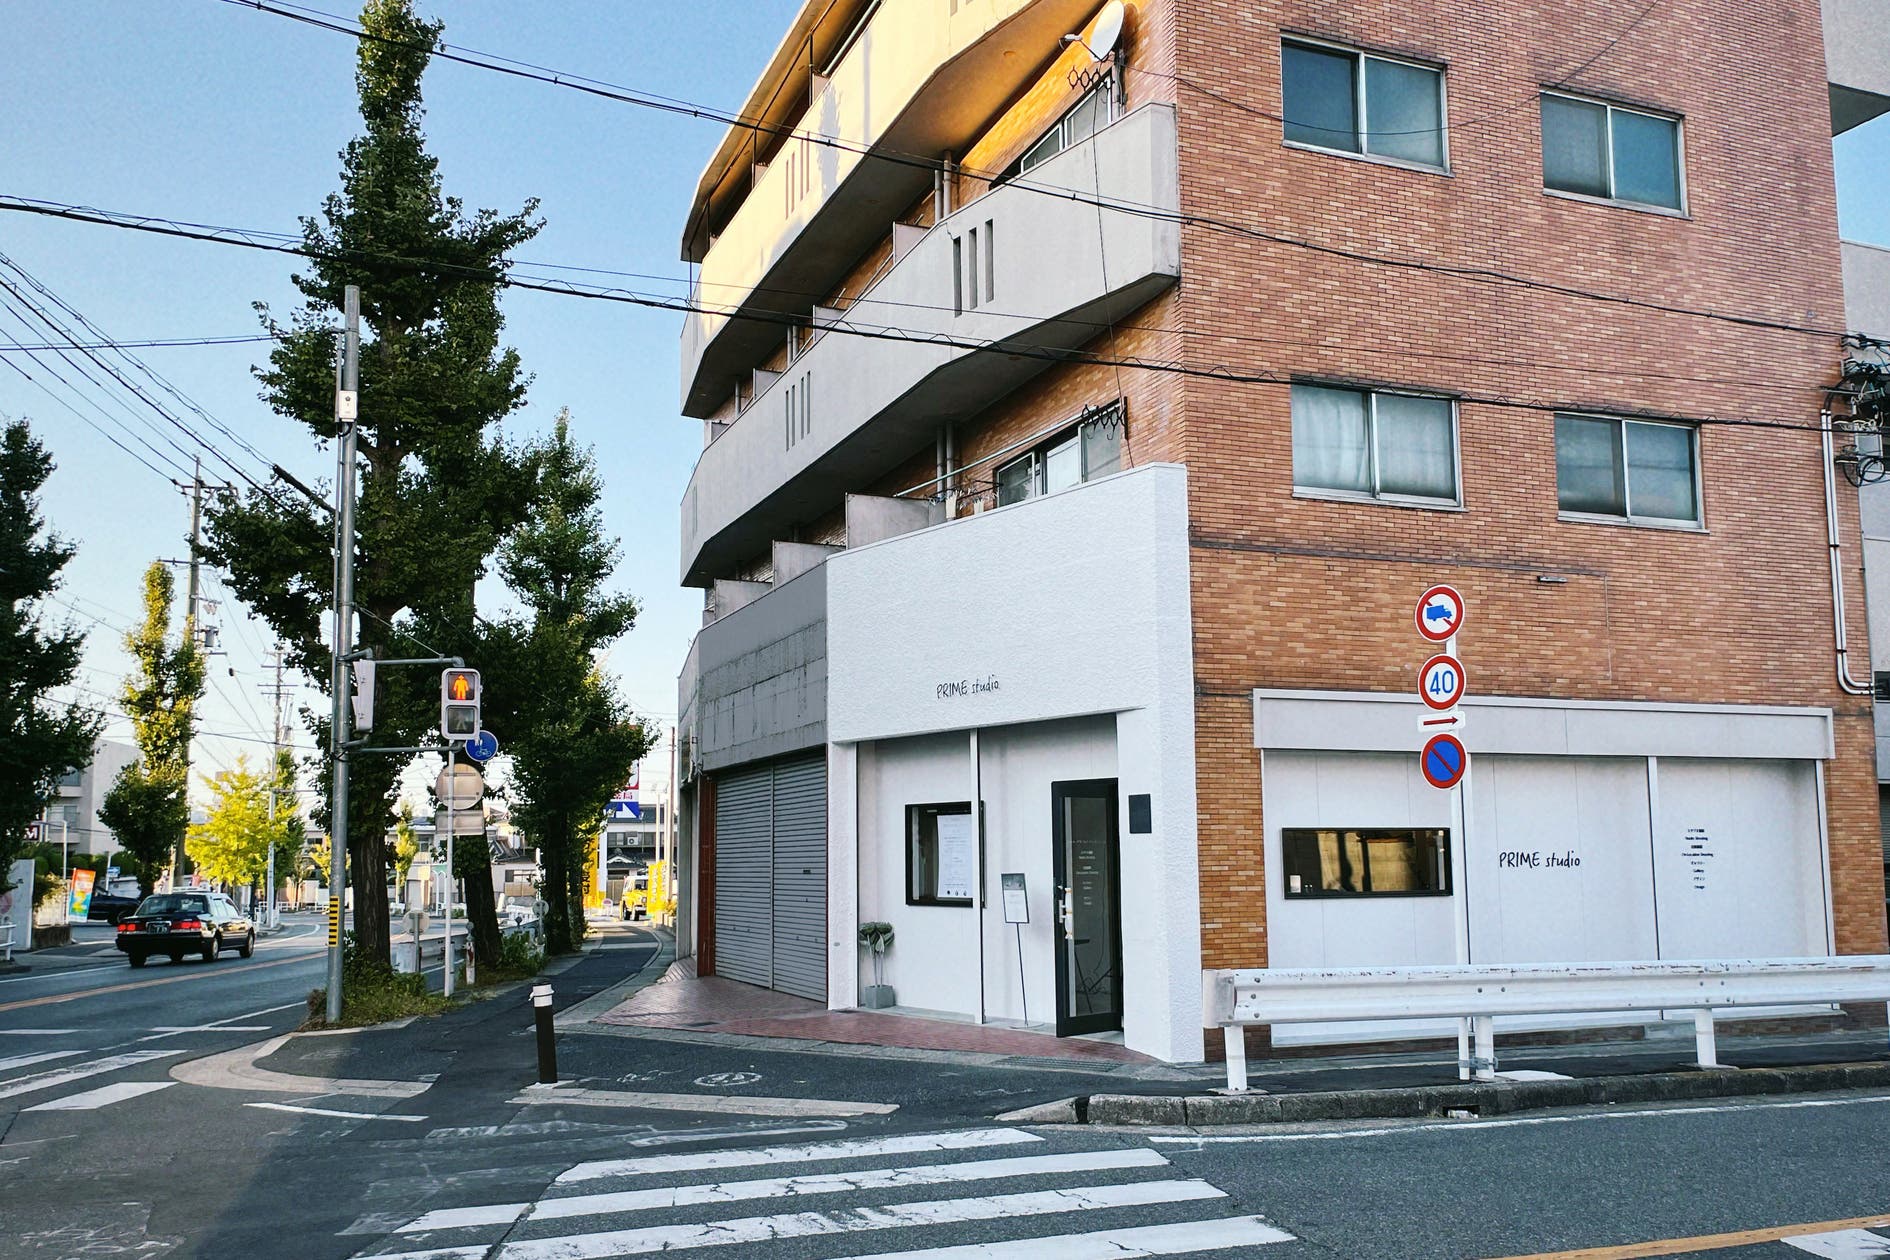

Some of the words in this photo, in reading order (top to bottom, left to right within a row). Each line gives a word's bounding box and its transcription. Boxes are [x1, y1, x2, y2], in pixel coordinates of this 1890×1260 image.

[936, 679, 968, 700] PRIME
[971, 674, 1000, 694] studio
[1430, 670, 1454, 695] 40
[1499, 851, 1540, 869] PRIME
[1545, 850, 1581, 868] studio
